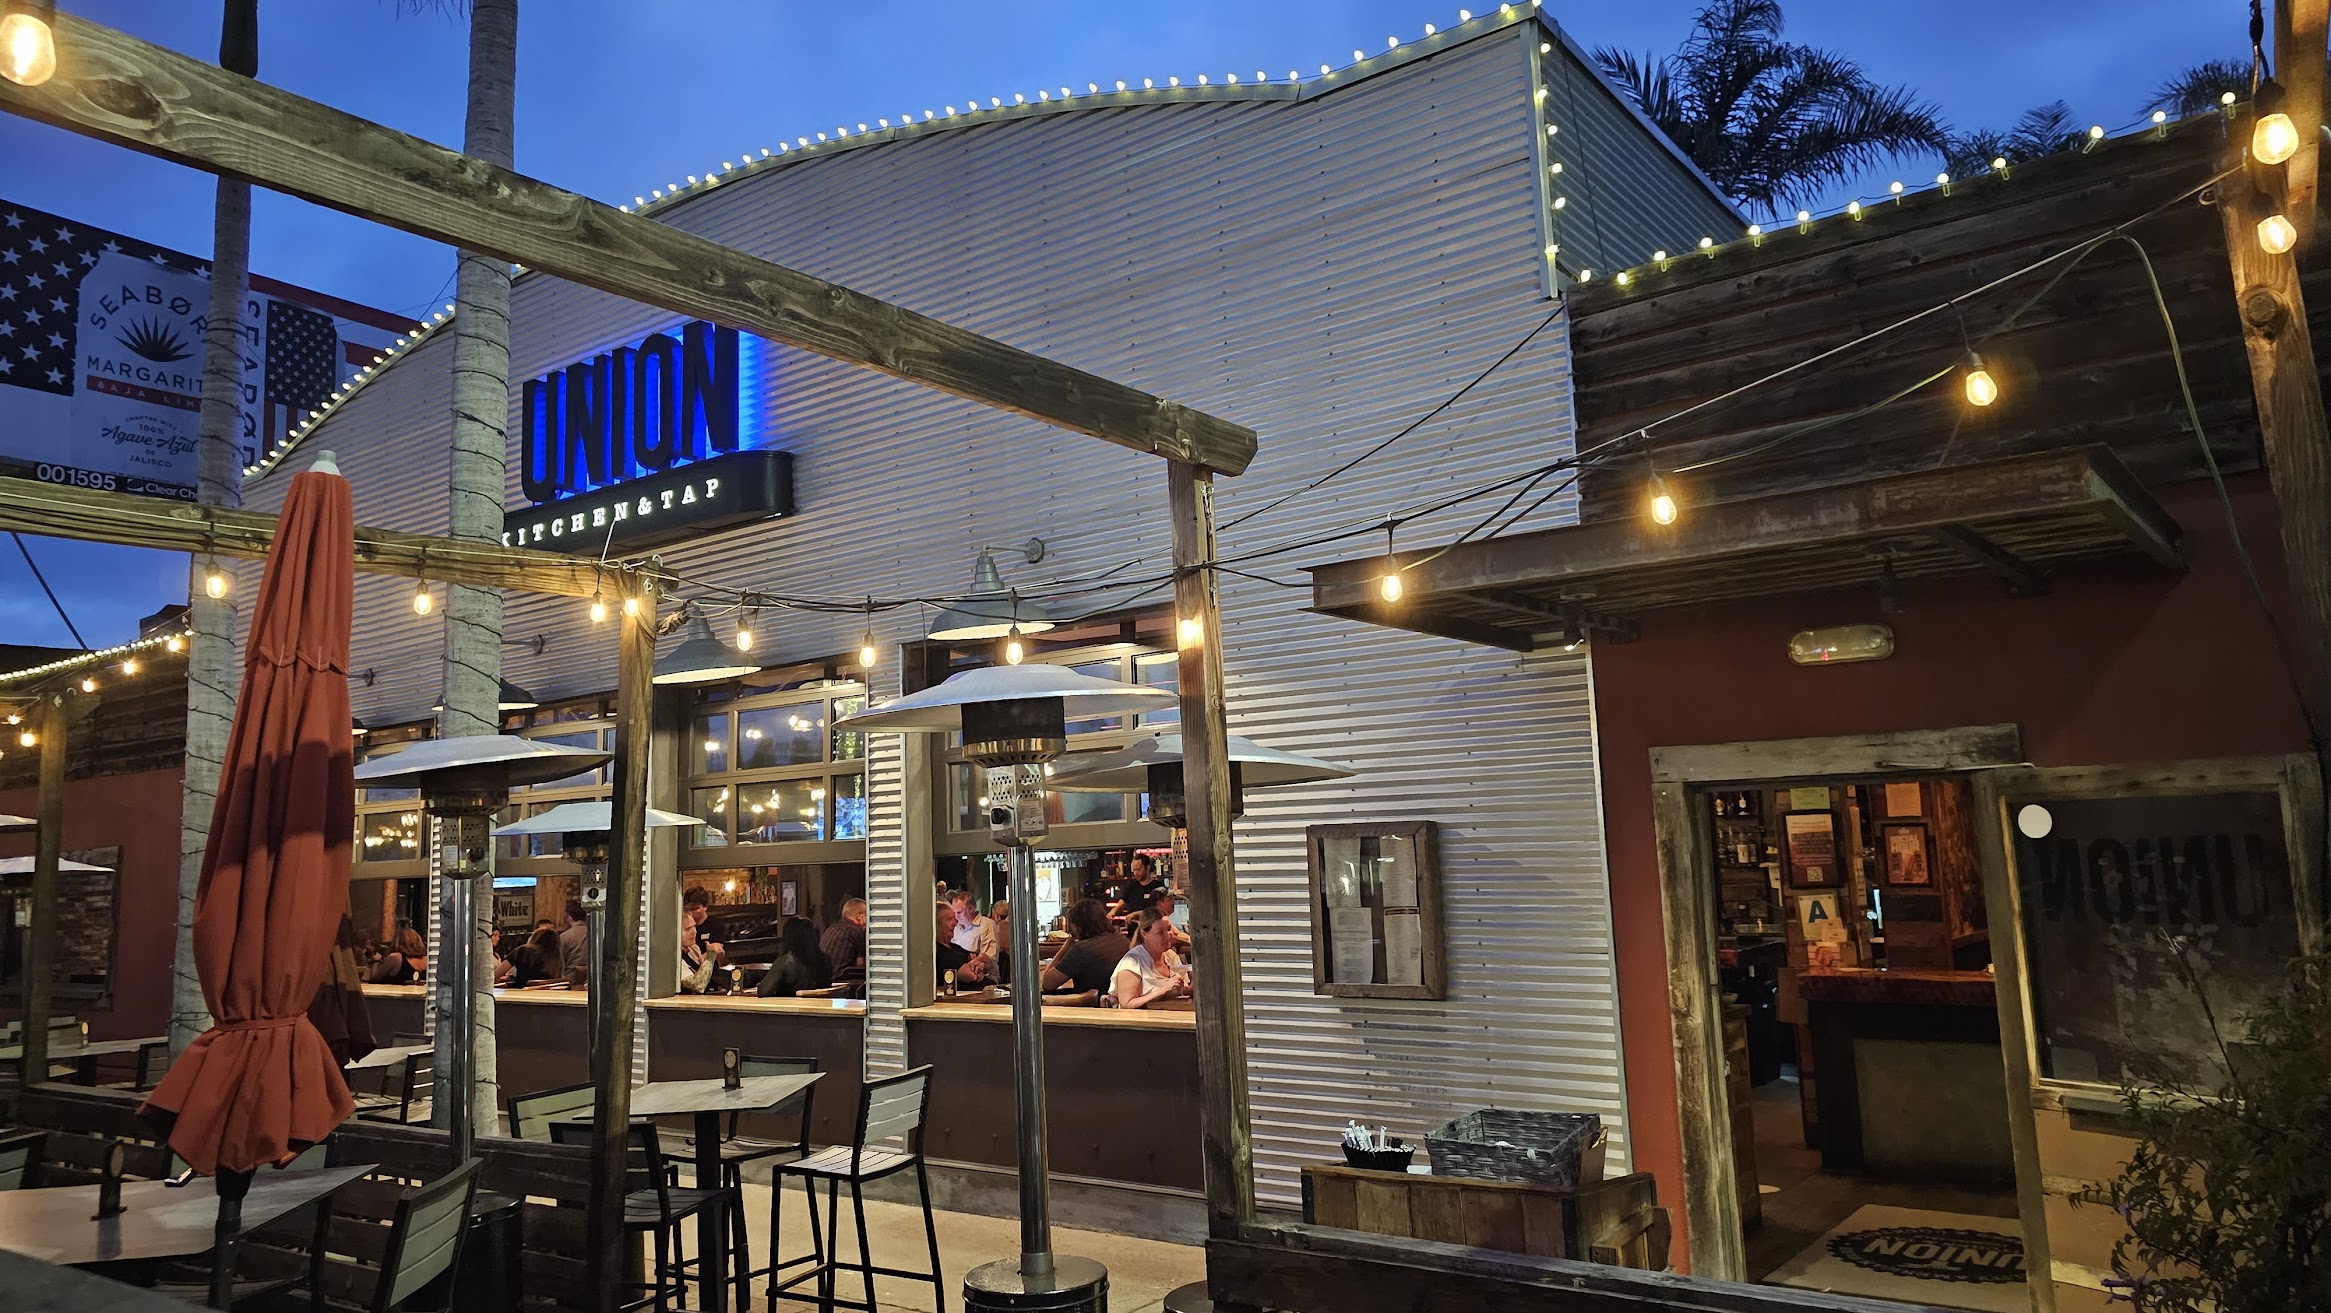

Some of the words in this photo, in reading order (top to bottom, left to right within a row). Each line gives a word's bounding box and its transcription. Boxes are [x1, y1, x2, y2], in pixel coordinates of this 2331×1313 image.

[90, 285, 208, 335] SEABØR
[87, 355, 203, 393] MARGARIT
[98, 381, 146, 398] BAJA
[521, 320, 740, 502] UNION
[139, 423, 165, 434] 100%
[101, 425, 155, 446] Agave
[156, 435, 199, 456] Azul
[145, 448, 156, 456] DE
[128, 454, 173, 468] JALISCO
[36, 463, 117, 491] 001595
[145, 482, 177, 497] Clear
[501, 900, 529, 917] White
[1808, 900, 1829, 923] A
[1862, 1238, 2027, 1270] UNION
